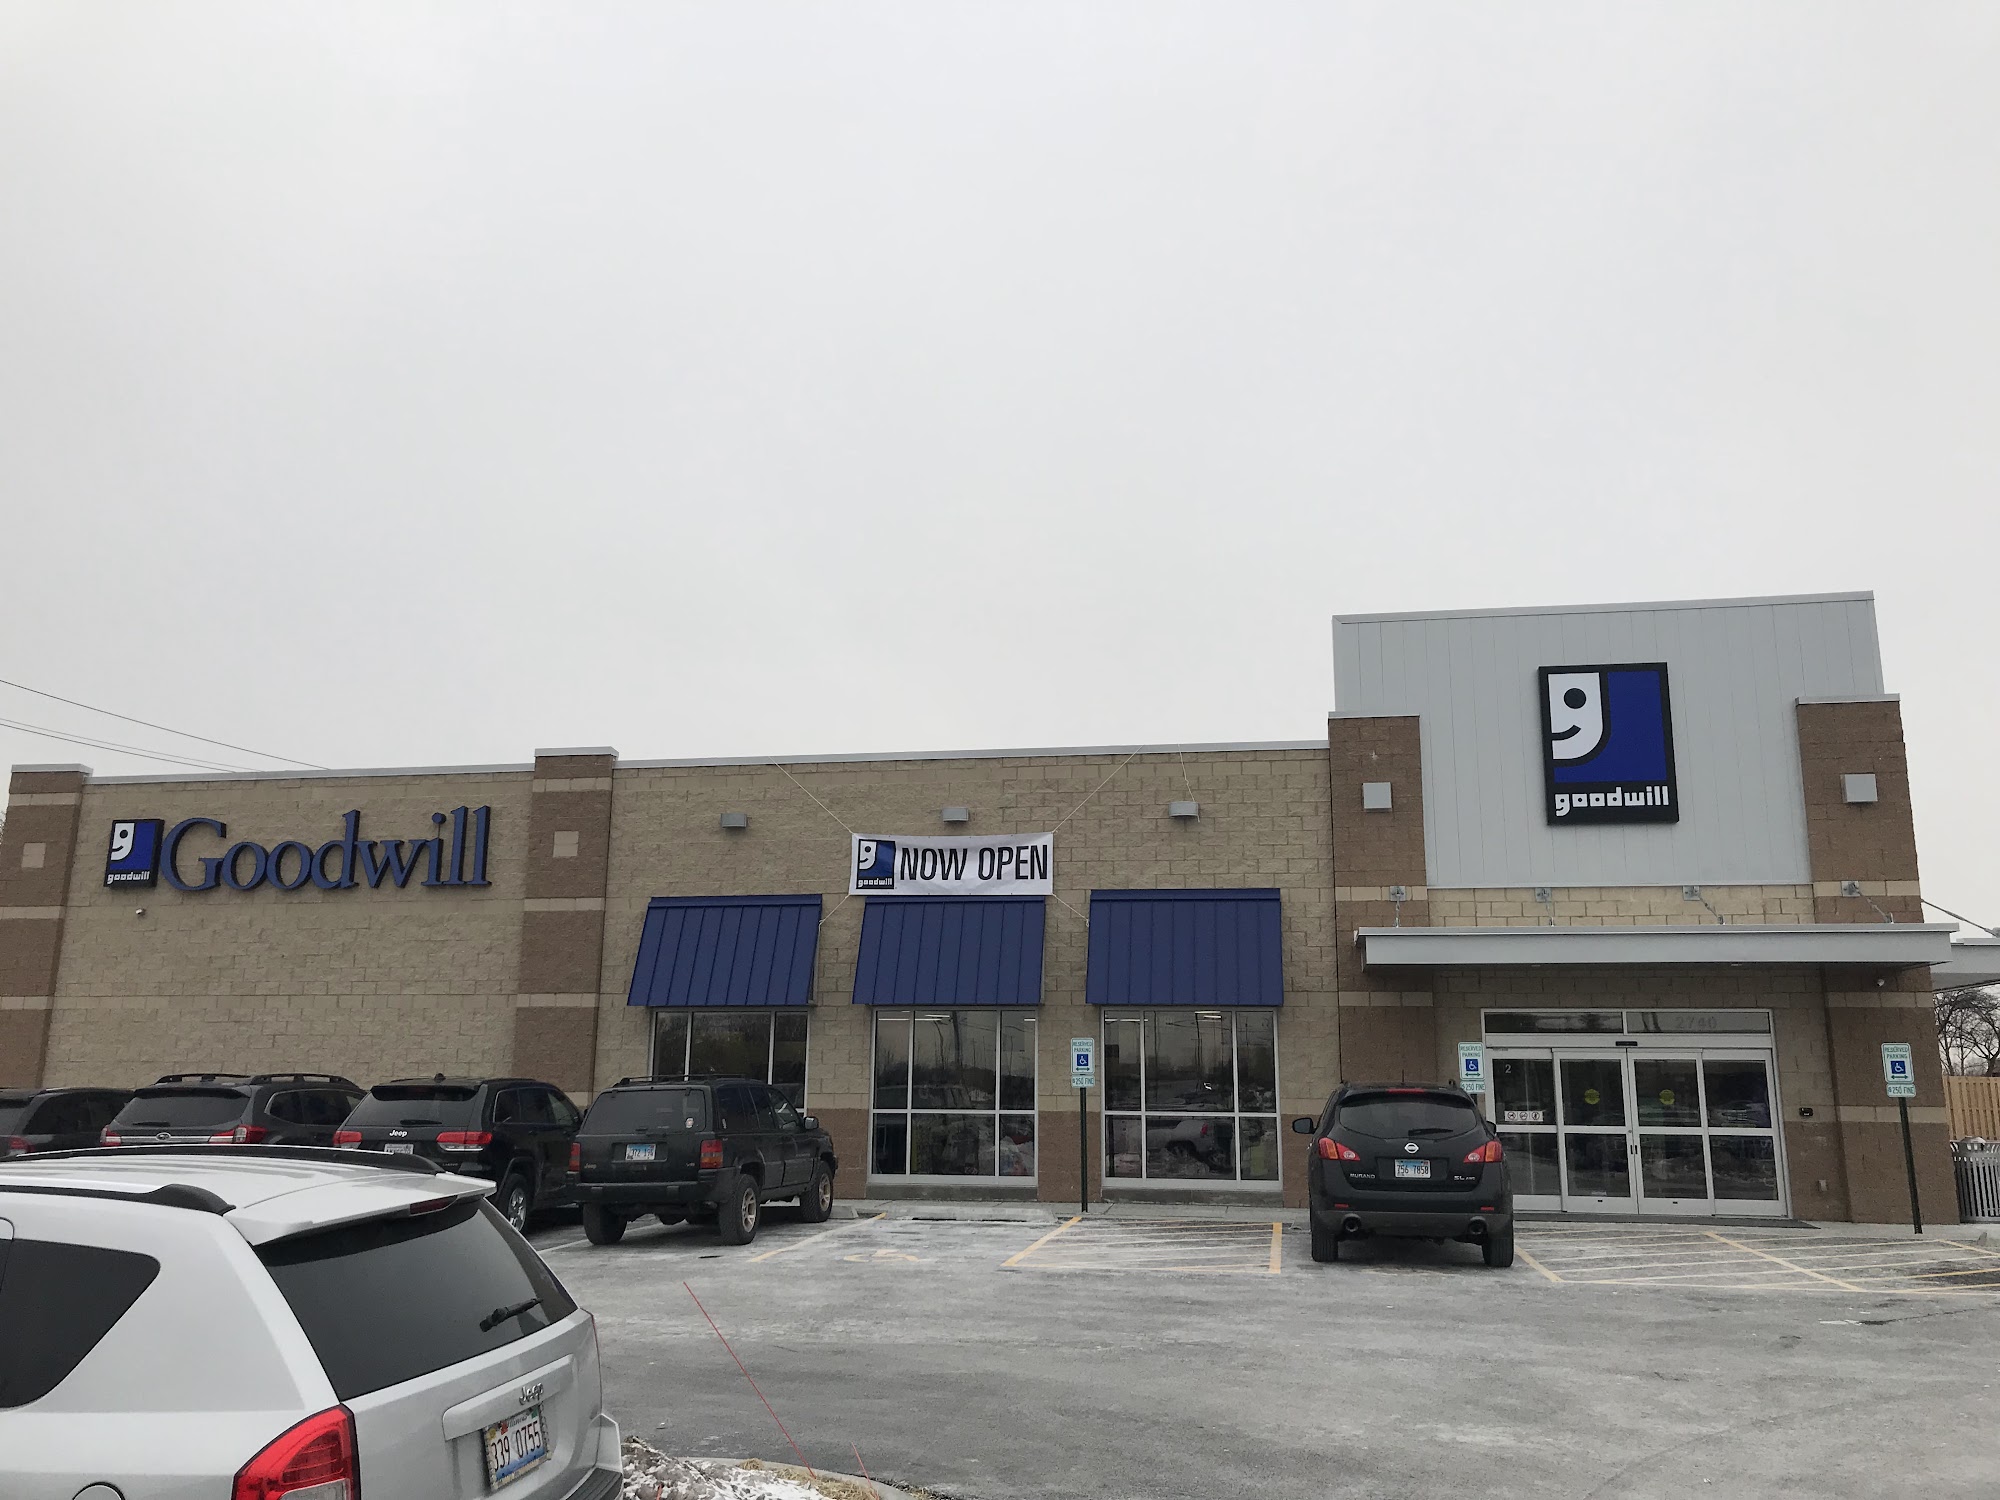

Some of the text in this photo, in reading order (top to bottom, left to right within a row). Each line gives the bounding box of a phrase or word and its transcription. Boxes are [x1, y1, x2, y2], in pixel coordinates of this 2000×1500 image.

[1554, 785, 1669, 817] goodwill
[160, 804, 493, 892] Goodwill
[900, 844, 1048, 881] NOW OPEN
[106, 870, 151, 885] goodwill
[857, 877, 893, 888] goodwill
[1505, 1063, 1512, 1074] 2
[1475, 1083, 1486, 1091] FINE
[1903, 1086, 1915, 1095] FINE
[389, 1129, 408, 1138] Jeep
[1397, 1164, 1409, 1174] 756
[1349, 1172, 1376, 1180] MURANO
[519, 1382, 544, 1406] Jeep
[491, 1420, 541, 1472] 339 0755
